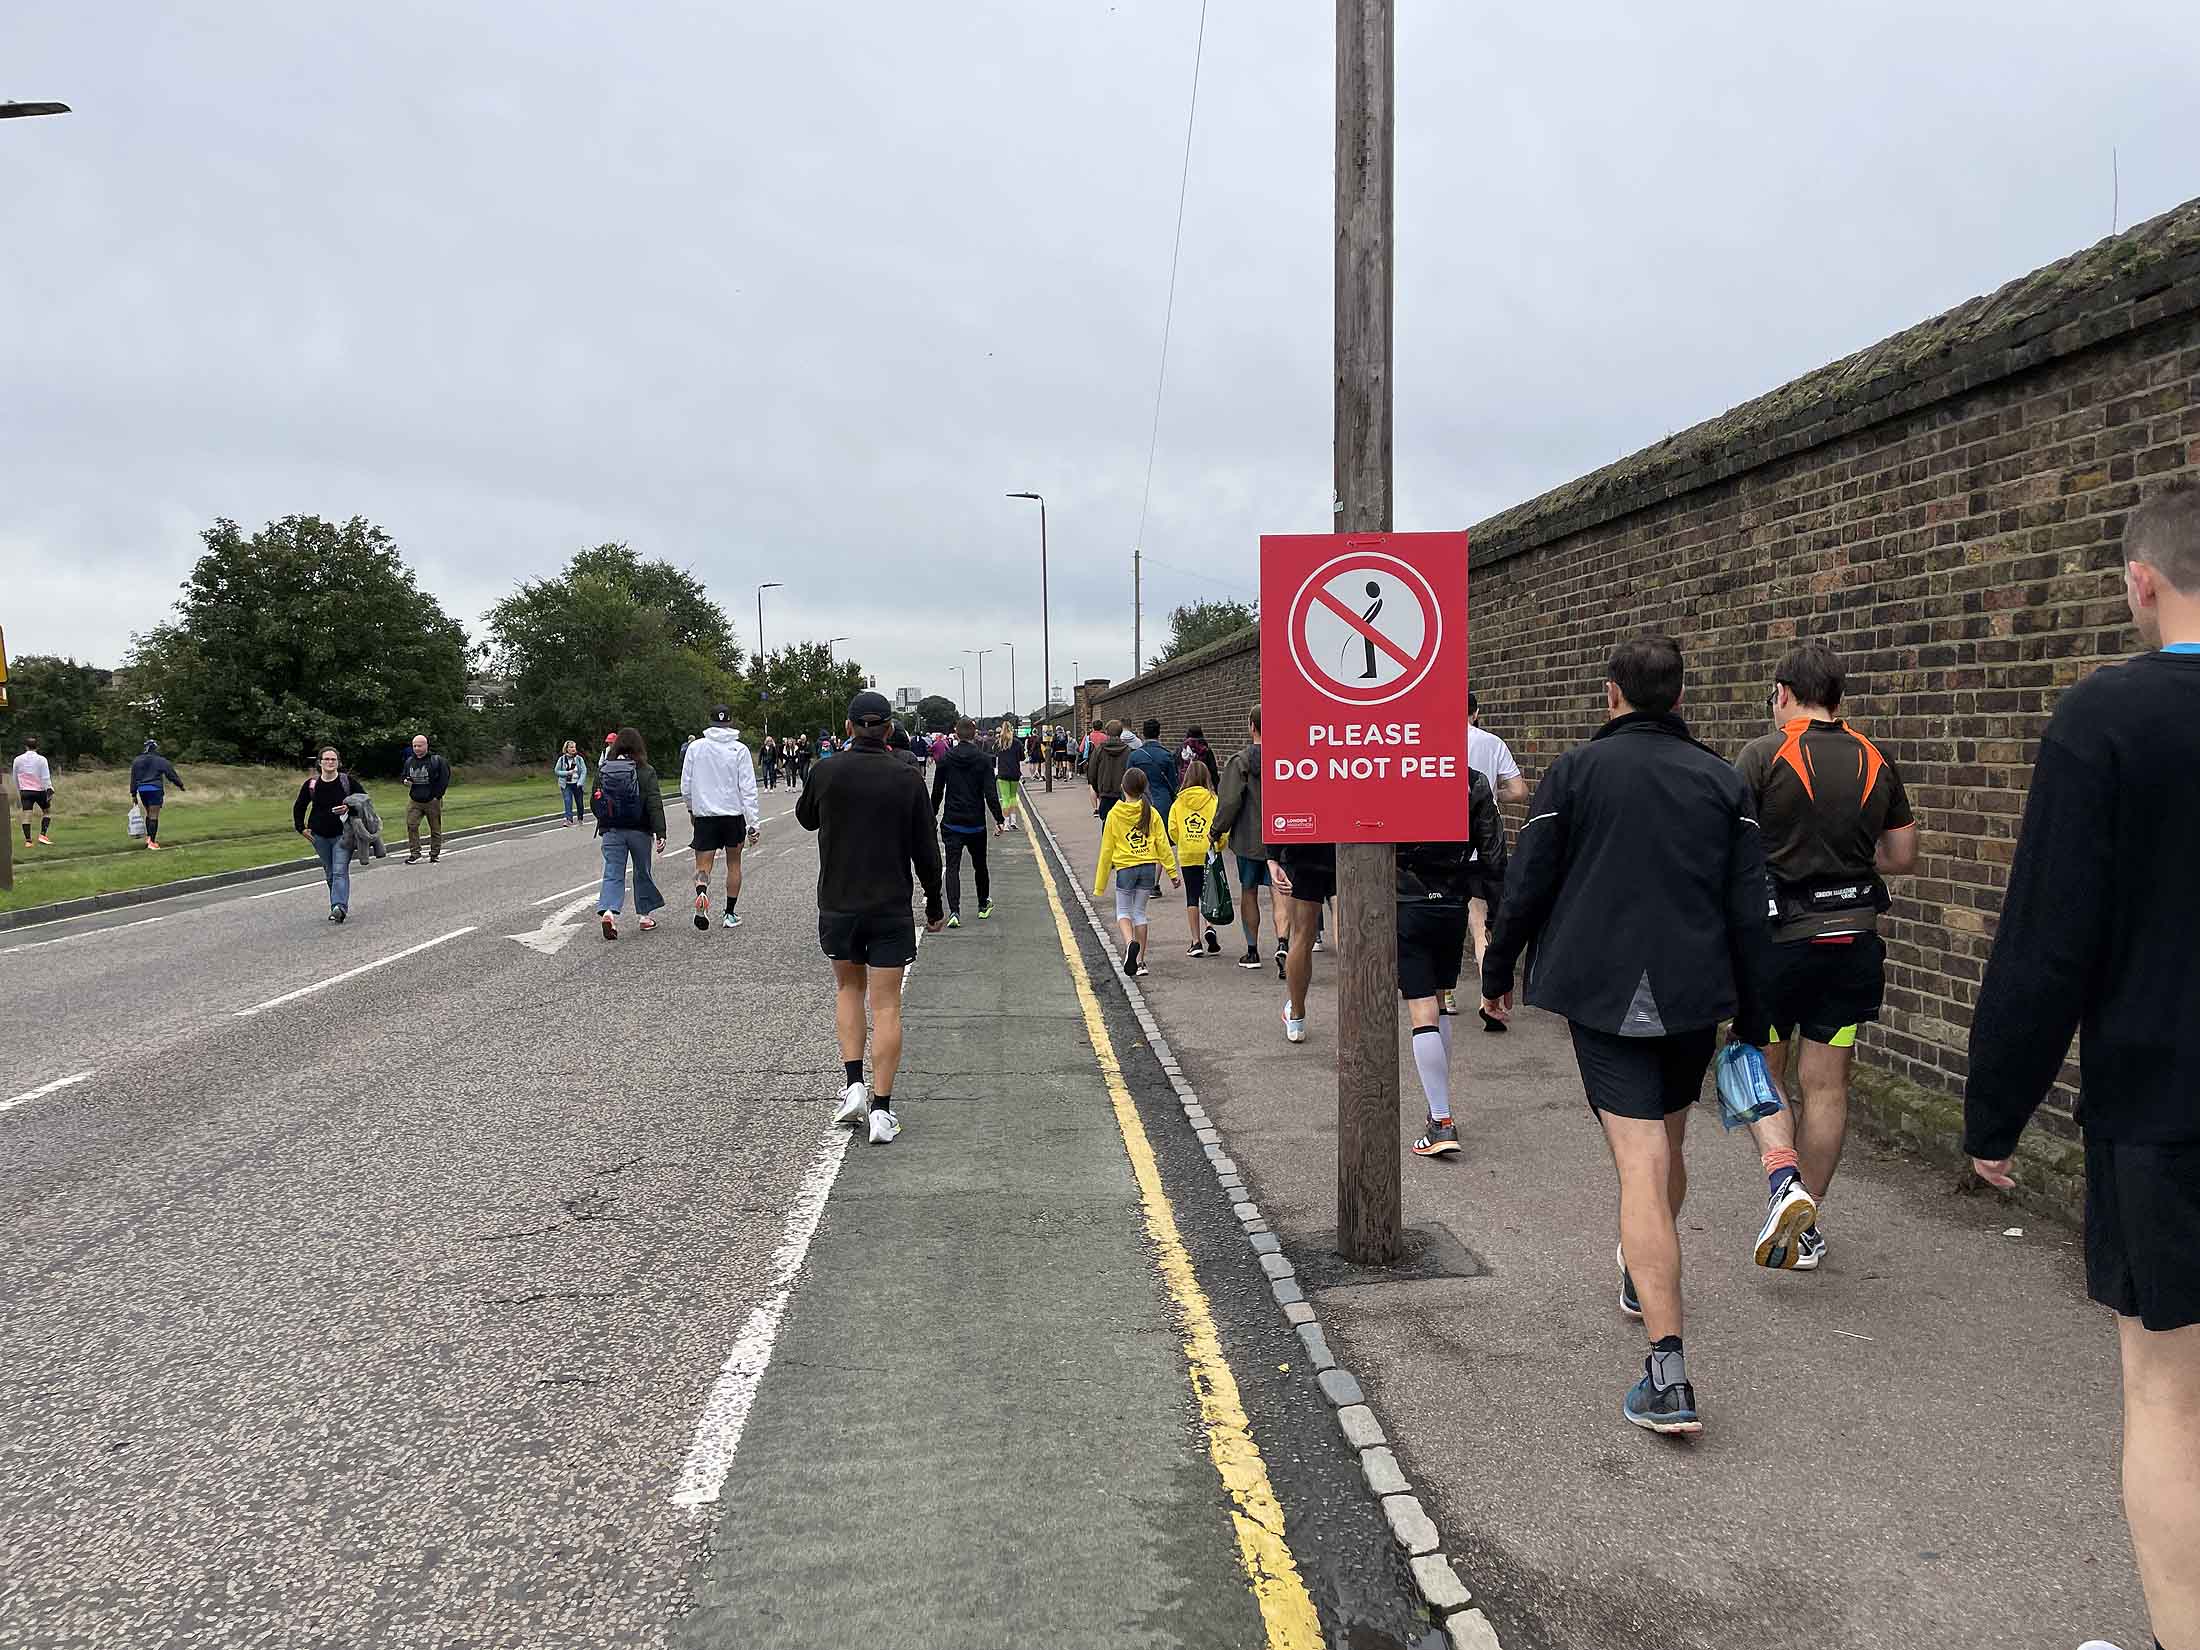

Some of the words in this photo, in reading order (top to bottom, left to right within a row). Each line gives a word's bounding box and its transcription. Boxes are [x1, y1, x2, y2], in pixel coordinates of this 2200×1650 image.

[1309, 723, 1421, 746] PLEASE
[1274, 758, 1319, 780] DO
[1328, 757, 1392, 780] NOT
[1400, 756, 1456, 779] PEE
